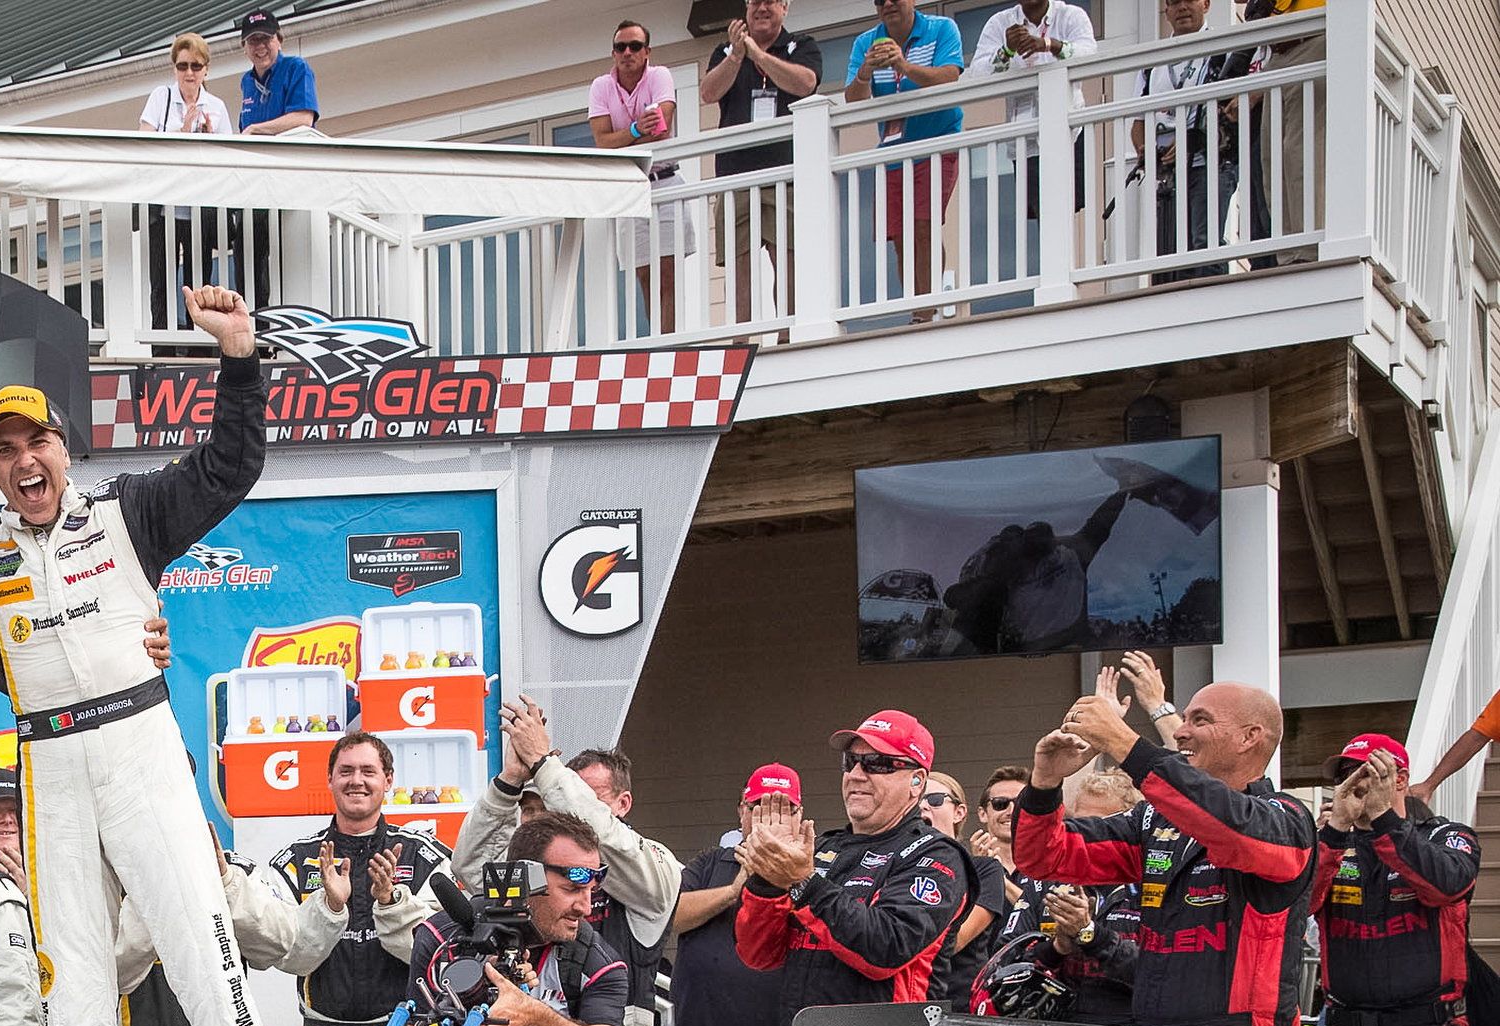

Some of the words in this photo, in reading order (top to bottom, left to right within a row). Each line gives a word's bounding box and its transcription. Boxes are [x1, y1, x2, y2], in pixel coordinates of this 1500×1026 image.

[374, 369, 492, 415] Glen
[143, 419, 486, 446] INTNATIONAL
[581, 510, 638, 521] GATORADE
[353, 550, 456, 564] WeatherTech
[63, 558, 116, 585] WHELEN
[160, 566, 222, 588] atkins
[227, 564, 273, 585] Glen
[541, 523, 640, 635] G
[65, 597, 101, 621] Sampling
[75, 708, 97, 722] JOAO
[97, 698, 134, 716] BARBOSA
[399, 686, 436, 727] G
[263, 750, 299, 790] G
[212, 913, 235, 972] Sampling
